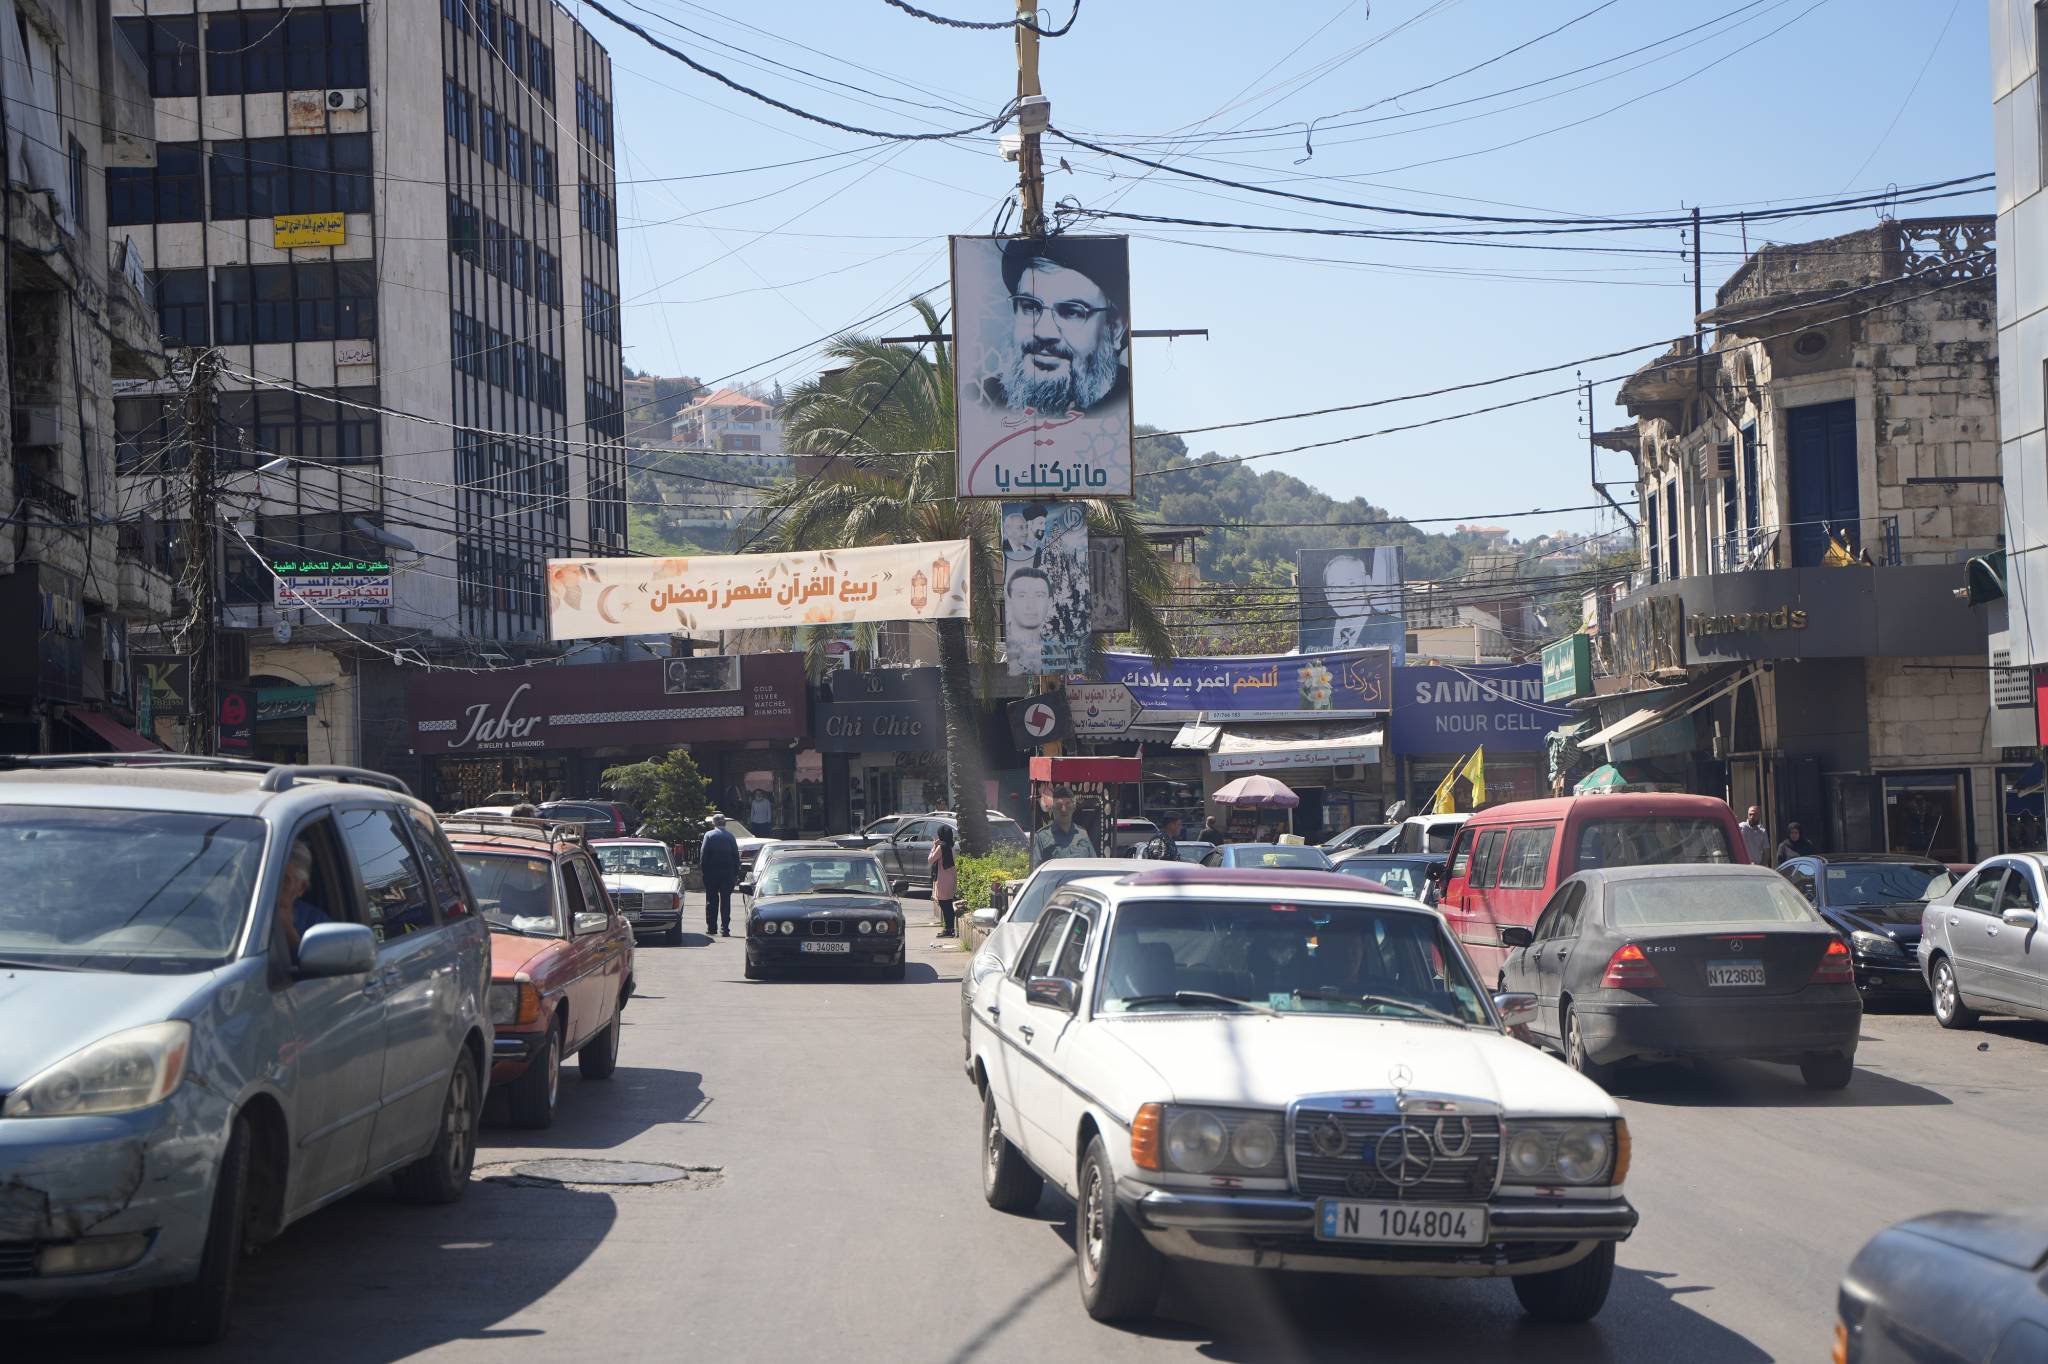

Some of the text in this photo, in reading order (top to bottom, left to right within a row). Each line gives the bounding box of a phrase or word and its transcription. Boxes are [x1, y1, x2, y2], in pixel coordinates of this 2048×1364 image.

[995, 463, 1010, 492] يا
[754, 685, 773, 693] GOLD
[754, 693, 778, 701] SILVER
[1416, 679, 1542, 704] SAMSUN
[754, 701, 786, 709] WATCHES
[754, 708, 792, 716] DIAMONDS
[448, 683, 542, 748] Jaber
[1436, 713, 1542, 733] NOUR CELL
[825, 714, 922, 738] Chi Chic
[504, 741, 510, 749] &
[511, 739, 545, 749] DIAMONDS
[1344, 1206, 1467, 1239] N 104804
